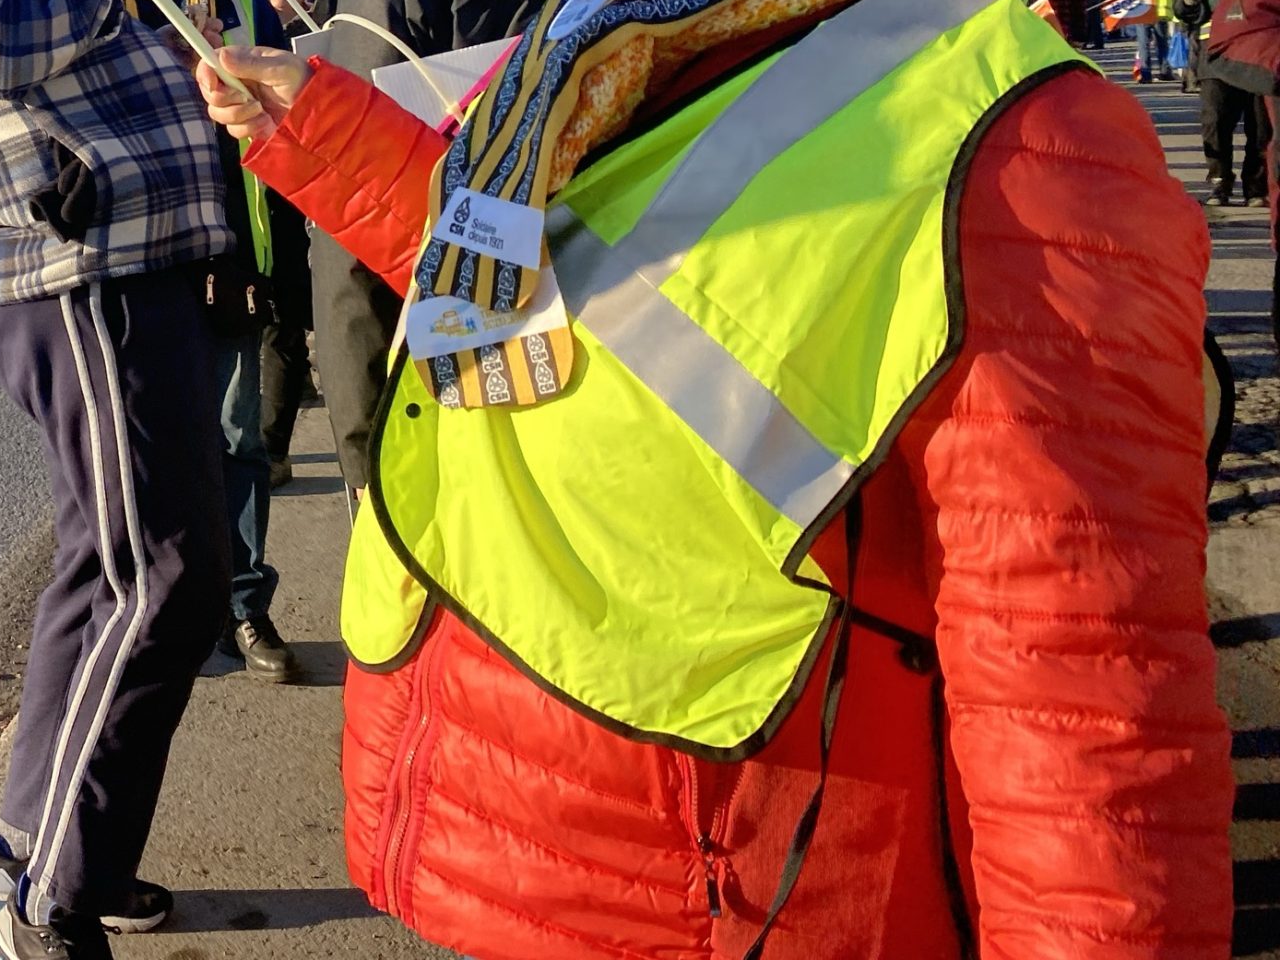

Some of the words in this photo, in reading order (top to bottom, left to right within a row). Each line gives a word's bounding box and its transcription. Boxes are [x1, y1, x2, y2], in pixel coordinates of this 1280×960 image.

[449, 223, 465, 236] CSN
[532, 353, 547, 361] CSN
[483, 362, 502, 371] CSN
[439, 373, 455, 381] CSN
